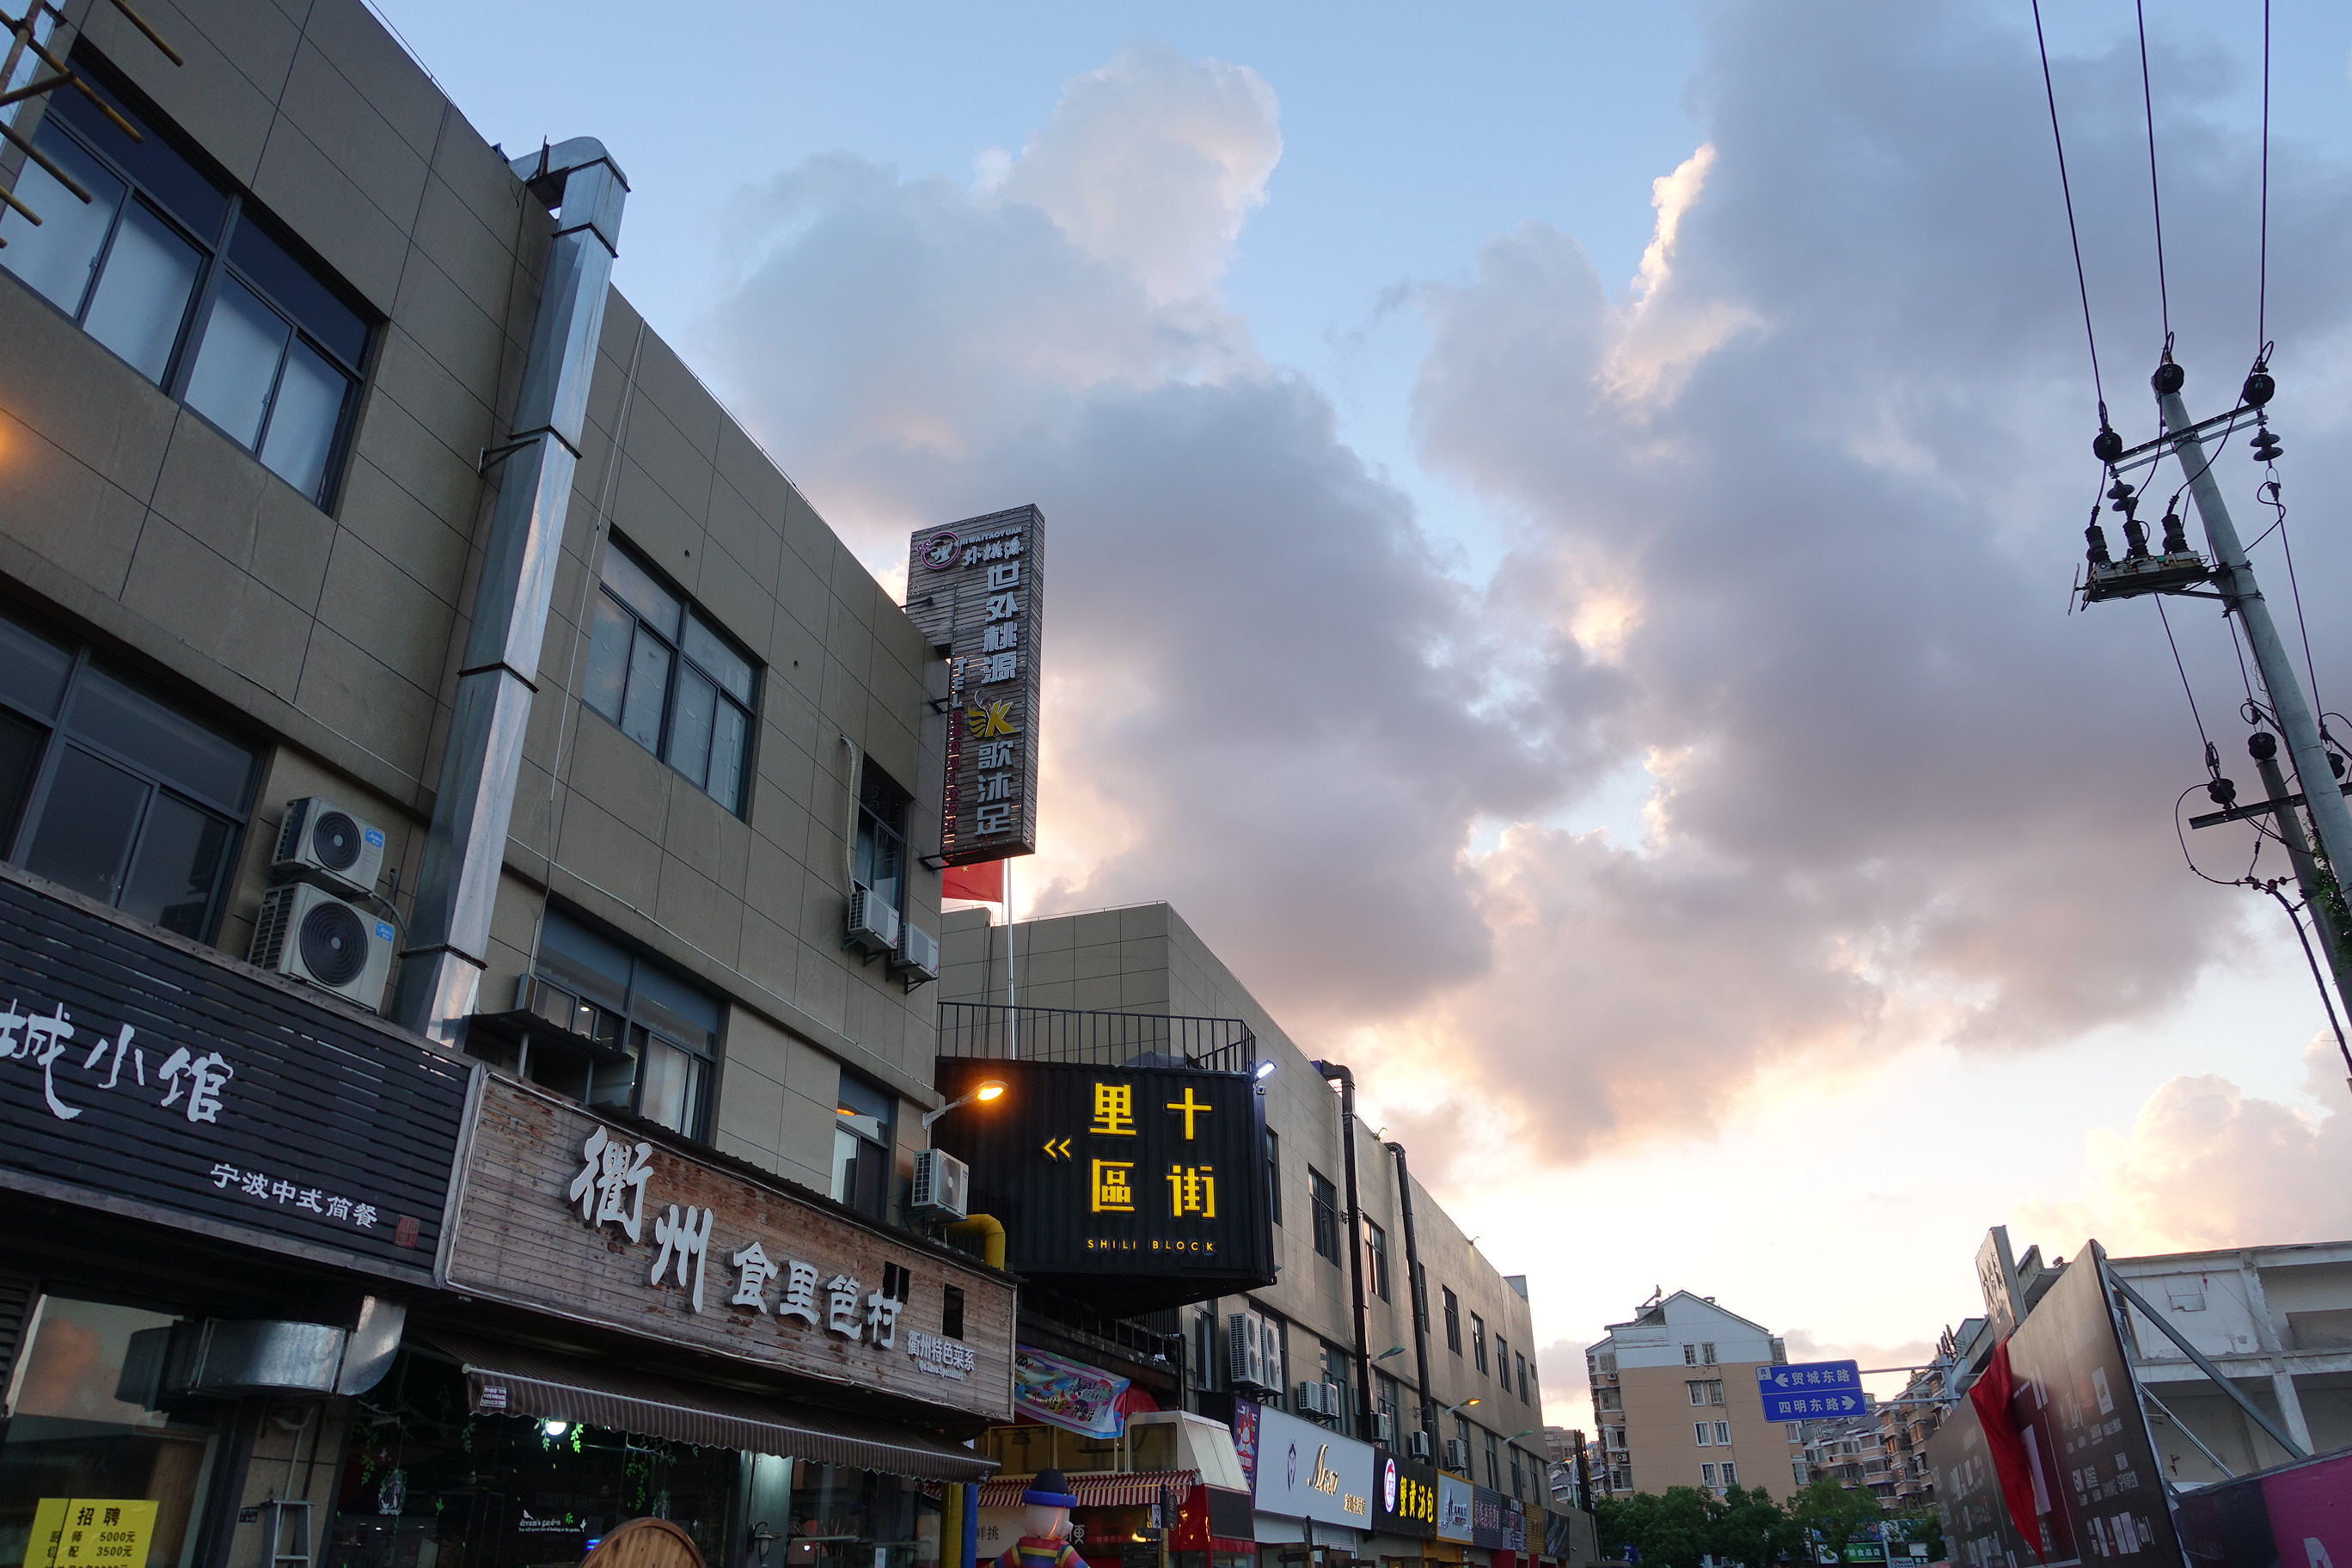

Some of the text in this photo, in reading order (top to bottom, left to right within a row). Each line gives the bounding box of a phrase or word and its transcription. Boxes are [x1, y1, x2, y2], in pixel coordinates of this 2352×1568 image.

[981, 560, 1020, 684] 世外桃源
[975, 739, 1014, 836] 歌沐足
[210, 1163, 377, 1228] 宁波中式简餐
[1087, 1239, 1213, 1251] SHILI BLOCK
[908, 1330, 975, 1371] 衢州特色菜系
[1792, 1369, 1850, 1386] 贸城东路
[1778, 1398, 1839, 1414] 四明东路
[1400, 1475, 1434, 1523] 蟹黄汤包
[77, 1507, 120, 1527] 招聘
[100, 1531, 135, 1542] 5000元
[96, 1546, 132, 1557] 3500元
